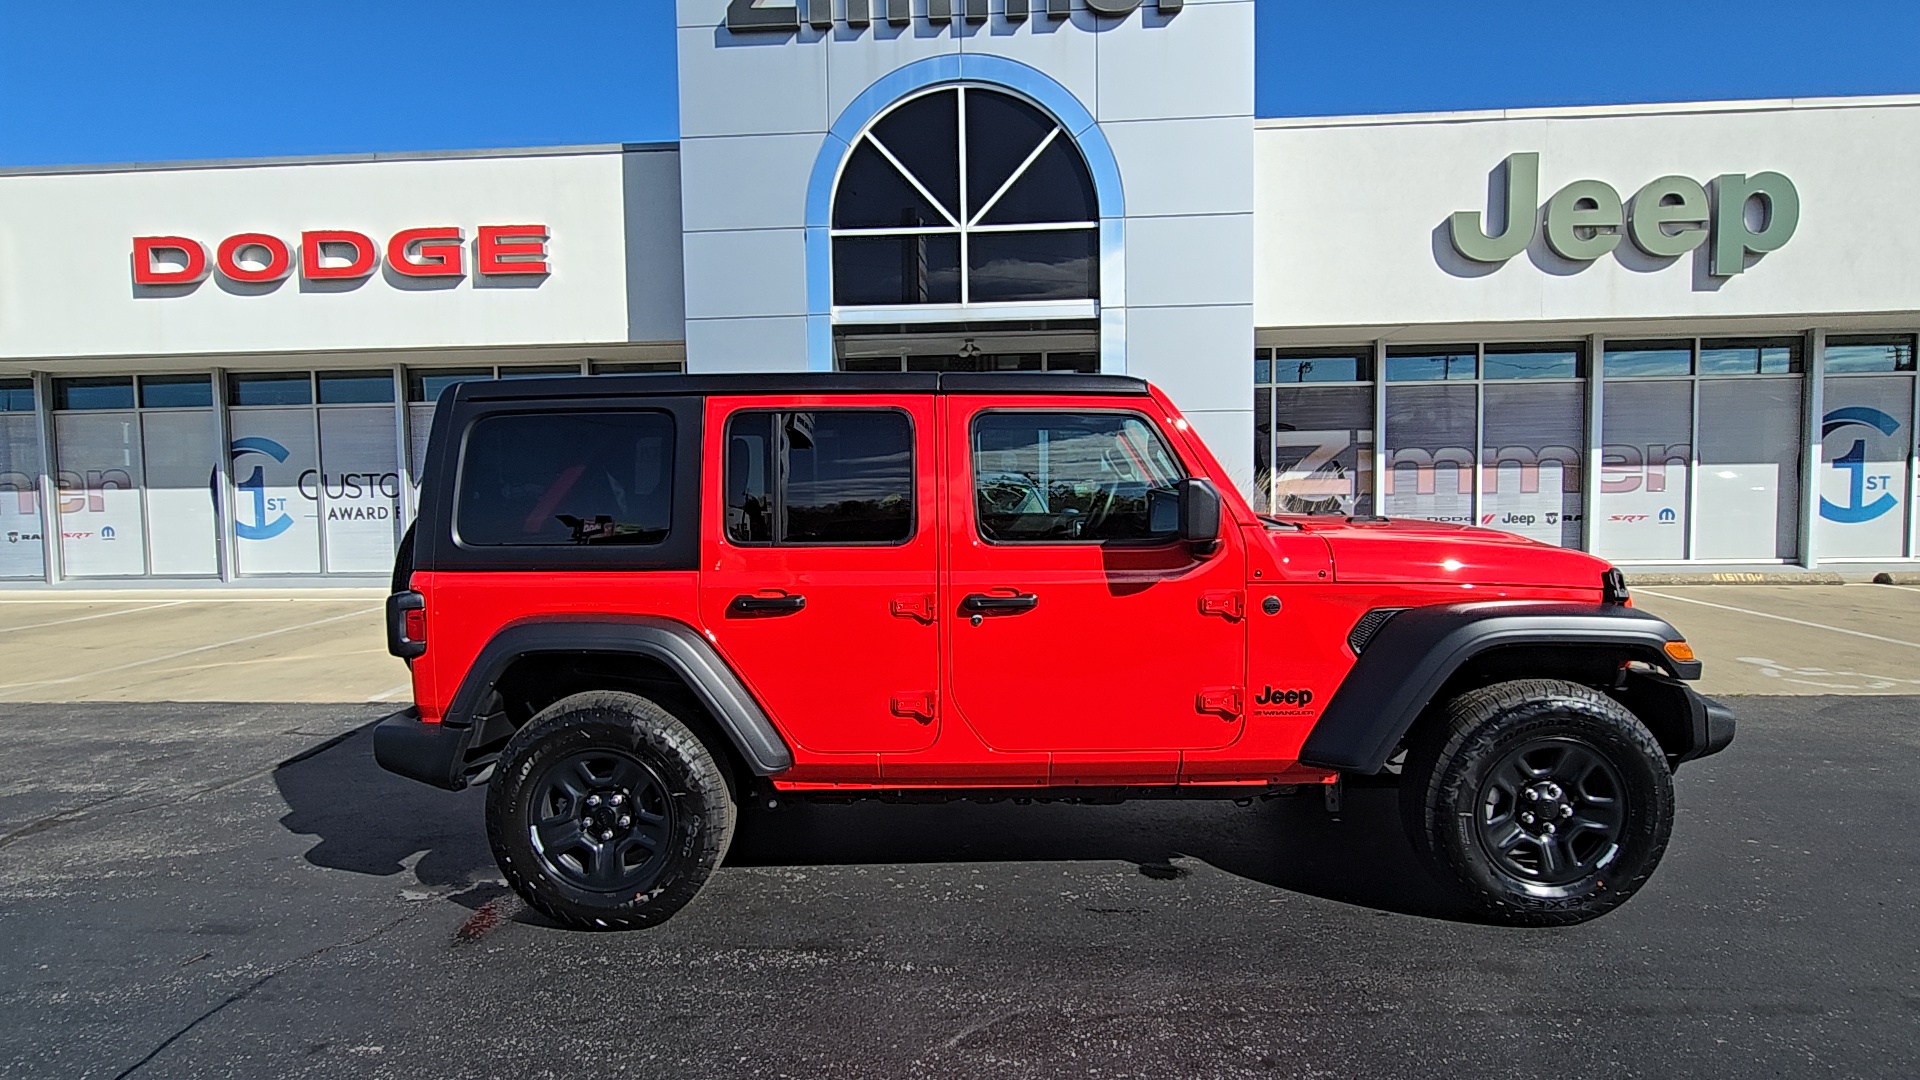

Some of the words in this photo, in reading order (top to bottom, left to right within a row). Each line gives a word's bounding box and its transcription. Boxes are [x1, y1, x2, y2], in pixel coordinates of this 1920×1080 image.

[1449, 151, 1800, 275] Jeep
[132, 224, 550, 285] DODGE
[297, 469, 422, 500] CUSTO
[328, 506, 389, 521] AWARD
[1502, 512, 1535, 526] Jeep
[1607, 515, 1650, 523] SRT
[63, 532, 94, 540] SRT
[1254, 684, 1313, 709] Jeep
